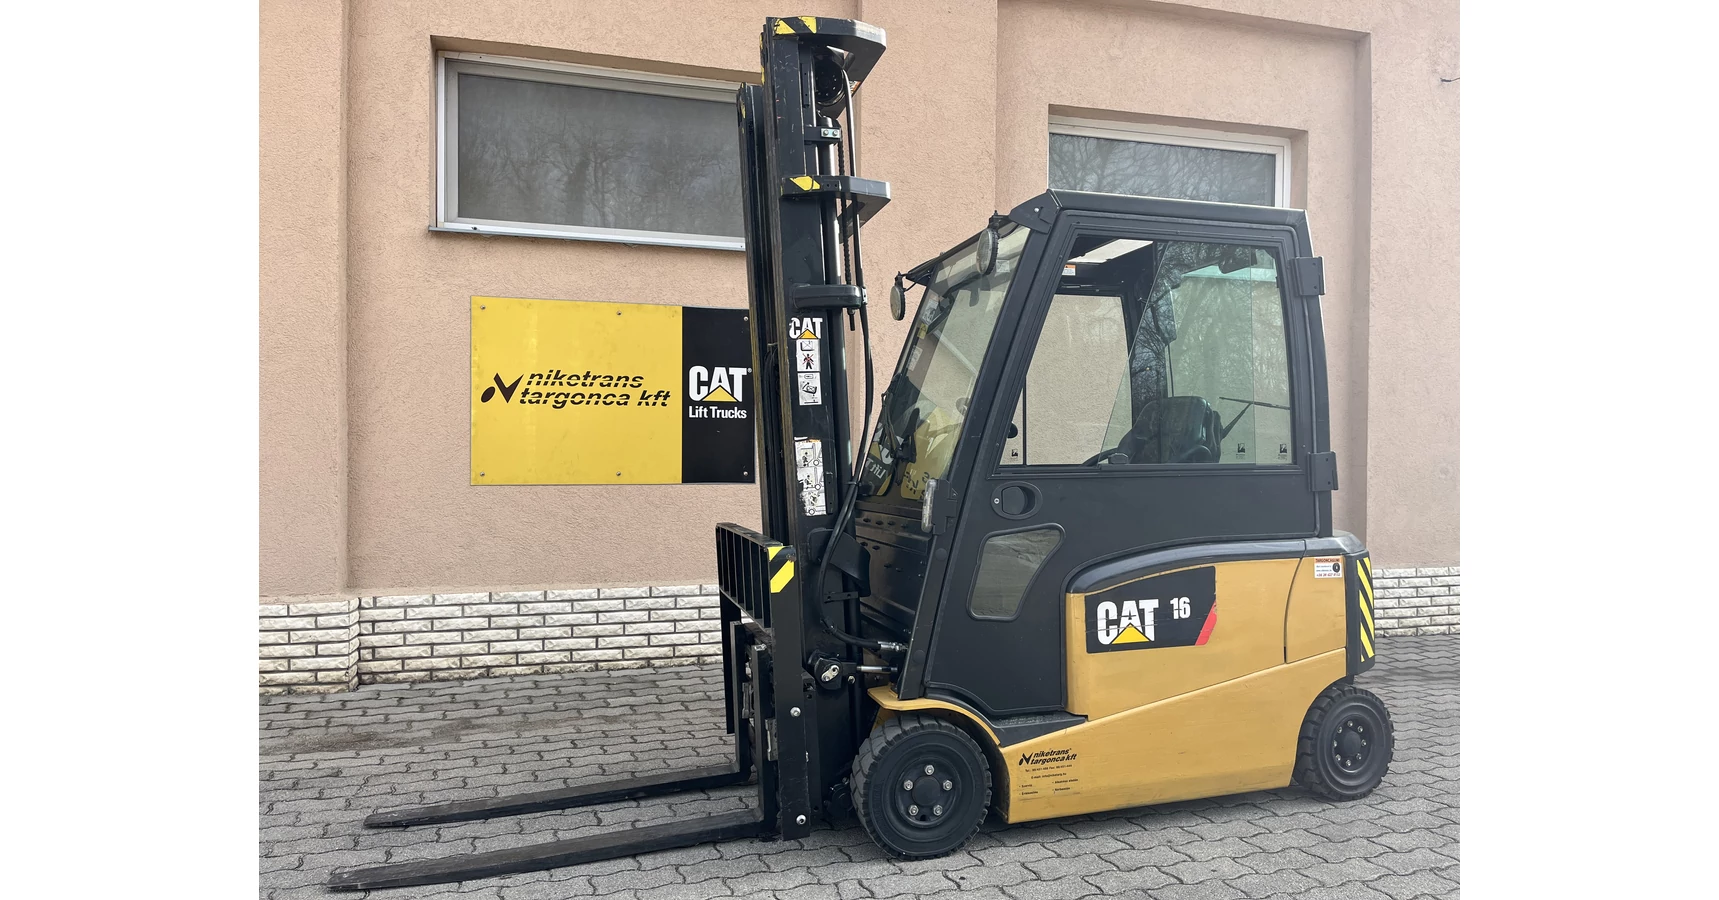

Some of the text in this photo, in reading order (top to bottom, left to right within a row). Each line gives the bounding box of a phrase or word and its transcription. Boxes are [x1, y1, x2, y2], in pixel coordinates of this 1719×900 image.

[789, 317, 823, 339] CAT
[526, 369, 645, 388] niketrans
[689, 365, 748, 402] CAT
[519, 387, 671, 410] targonca kft
[688, 405, 748, 419] Lift Trucks
[1096, 596, 1191, 645] CAT 16
[1031, 755, 1064, 765] targonca
[1033, 749, 1069, 758] niketrans
